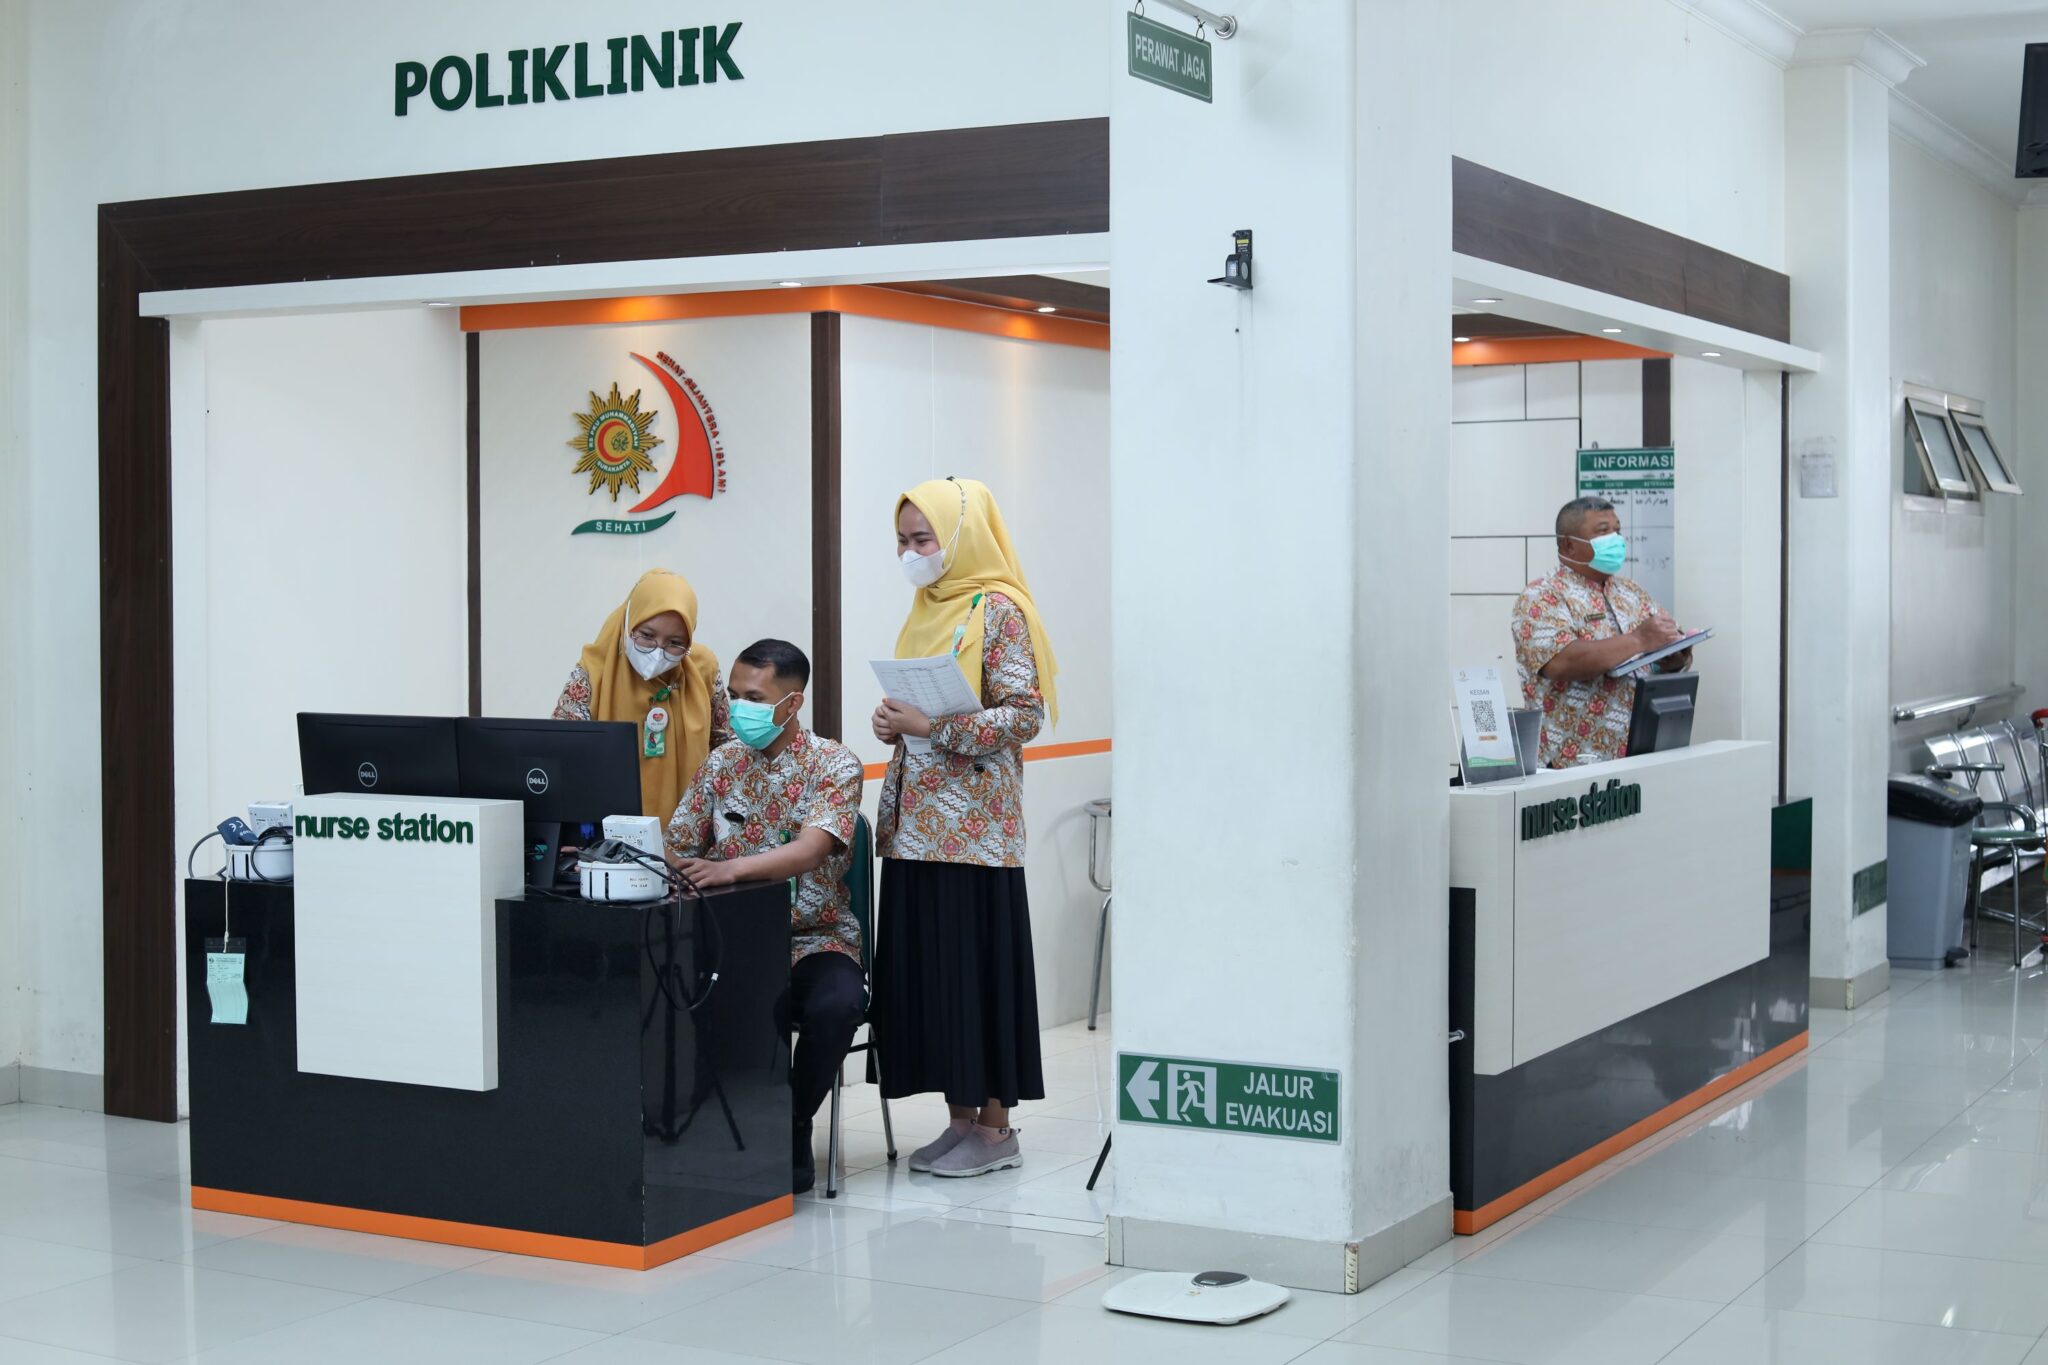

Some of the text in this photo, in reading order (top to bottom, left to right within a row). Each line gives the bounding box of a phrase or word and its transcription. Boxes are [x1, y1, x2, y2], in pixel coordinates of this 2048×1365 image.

[395, 22, 744, 116] POLIKLINIK
[1135, 33, 1206, 83] PERAWAT JAGA
[1593, 455, 1674, 469] INFORMASI
[595, 521, 646, 533] SEHATI
[529, 777, 546, 785] DELL
[1521, 778, 1642, 841] nurse station
[295, 813, 474, 844] nurse station
[1243, 1071, 1315, 1100] JALUR
[1225, 1102, 1332, 1135] EVAKUASI
